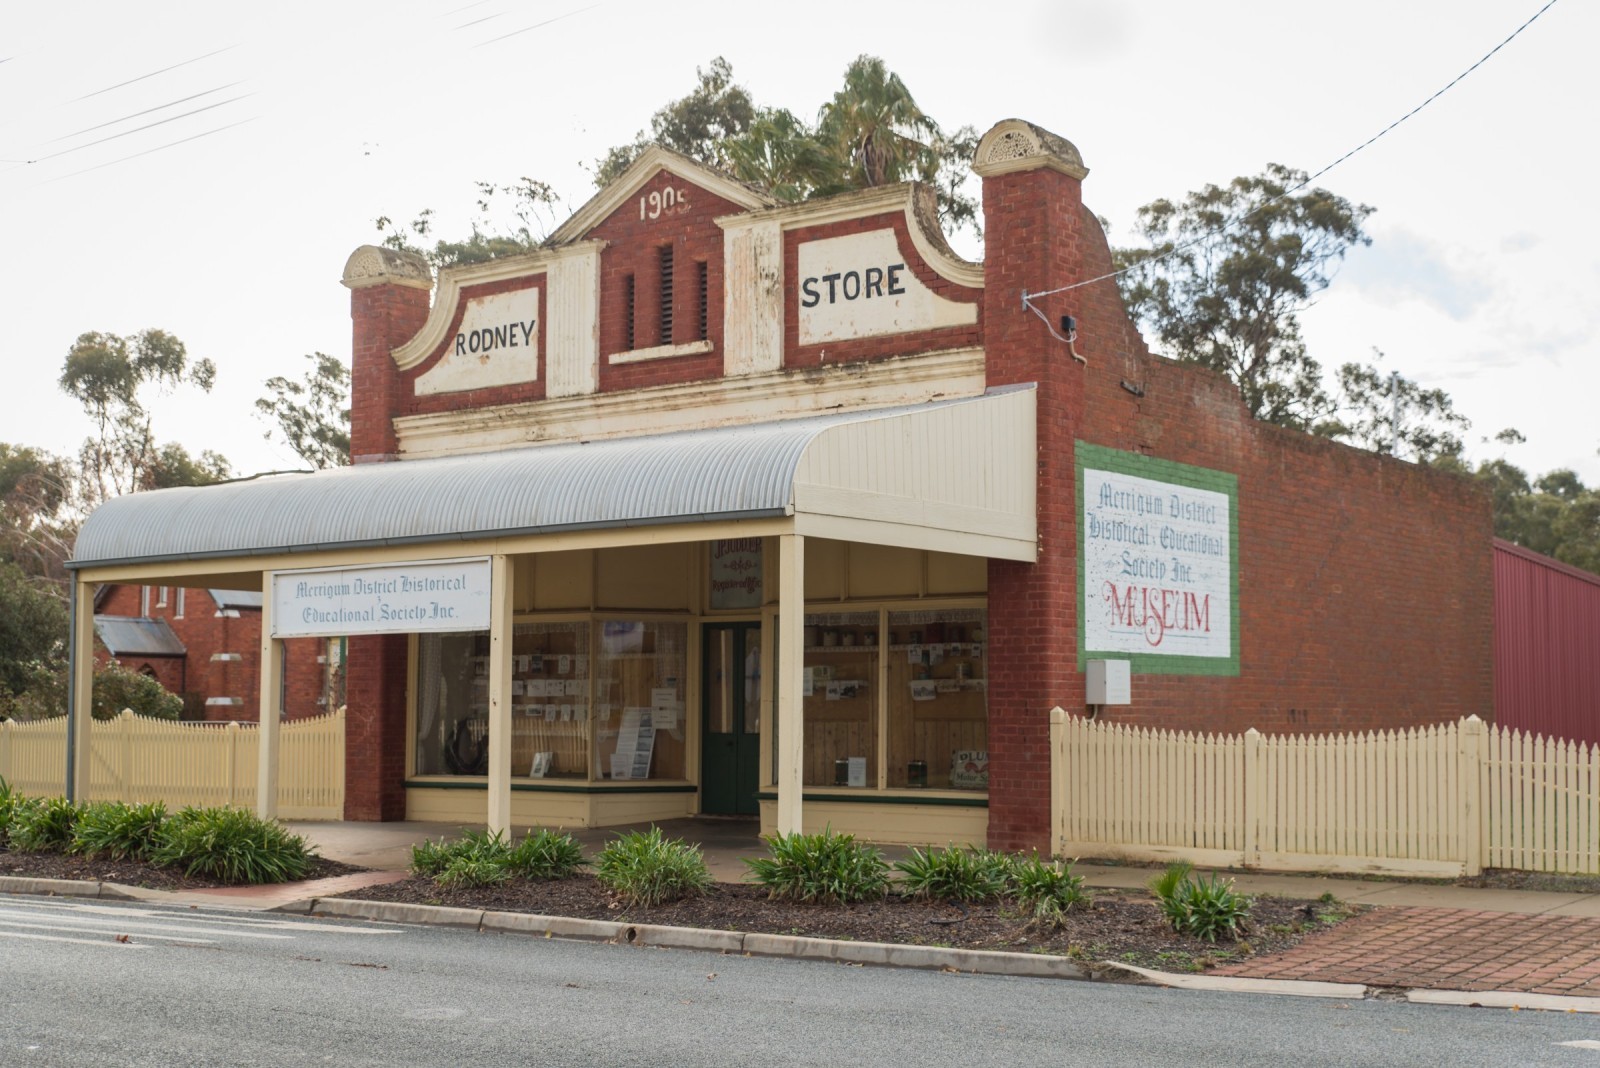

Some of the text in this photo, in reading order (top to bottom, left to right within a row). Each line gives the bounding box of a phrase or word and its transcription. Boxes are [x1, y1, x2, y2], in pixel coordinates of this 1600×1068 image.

[802, 263, 906, 308] STORE
[456, 320, 535, 356] RODNEY
[1096, 482, 1216, 524] Merrigum District
[1087, 512, 1150, 546] Historical
[1160, 525, 1223, 556] Educational
[295, 574, 466, 599] Merrigum District Historical
[1120, 550, 1195, 584] Society Inc.
[302, 601, 459, 624] Educational Society Inc.
[1102, 580, 1211, 646] MUSEUM
